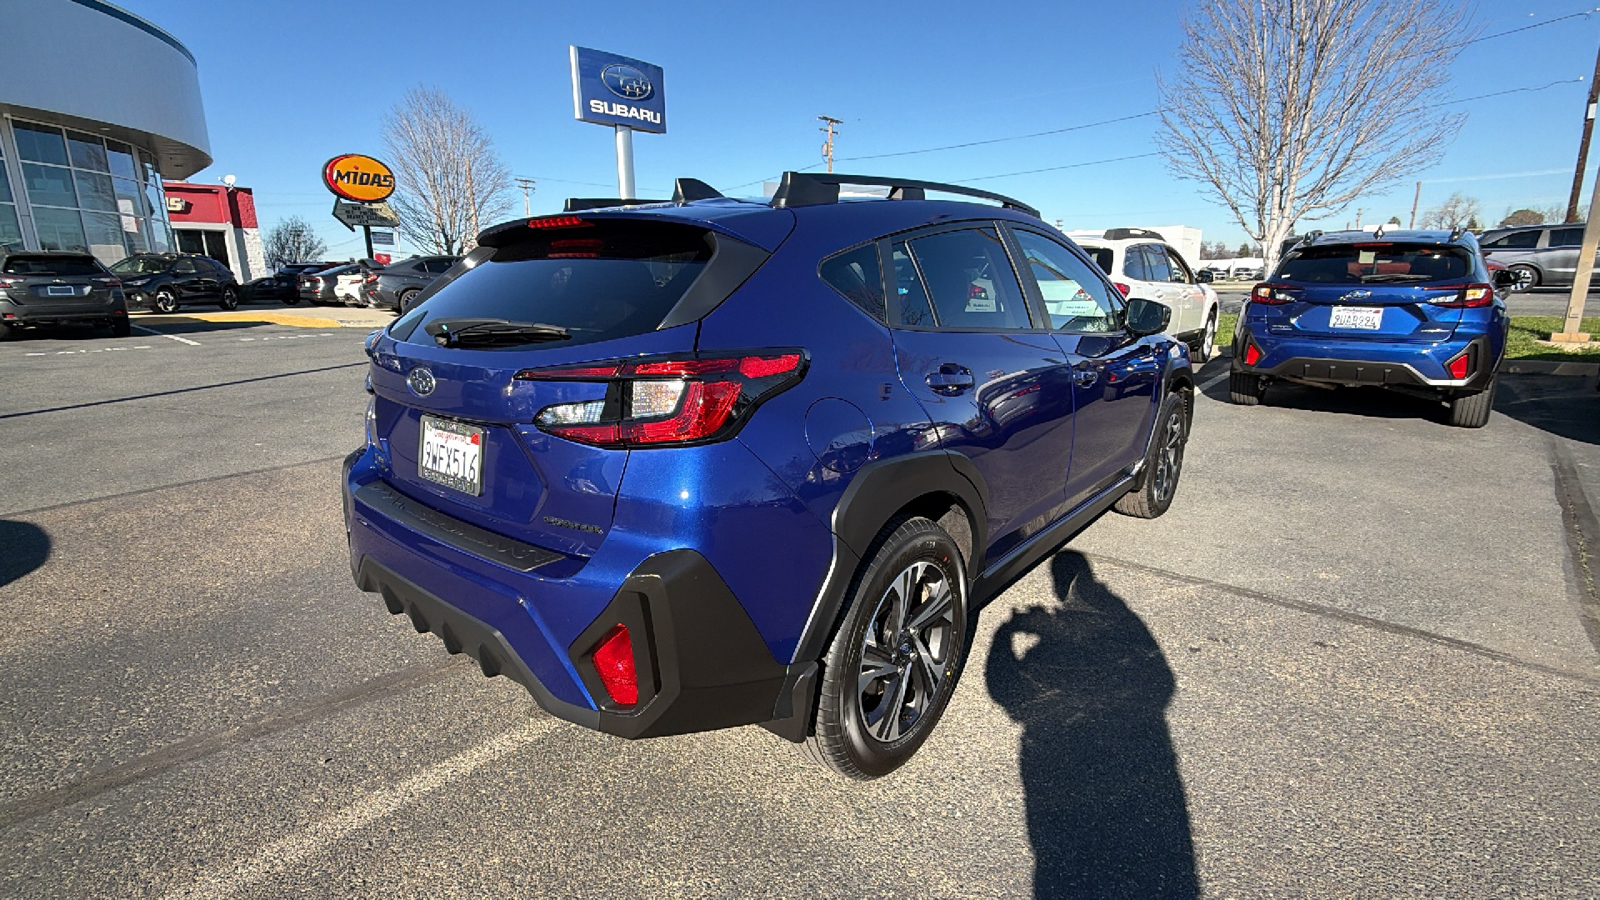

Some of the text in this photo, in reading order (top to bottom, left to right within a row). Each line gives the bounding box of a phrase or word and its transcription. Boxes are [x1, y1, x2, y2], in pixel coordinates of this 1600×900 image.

[589, 99, 661, 124] SUBARU
[333, 166, 393, 188] MIDAS
[425, 441, 478, 483] 9WFX516
